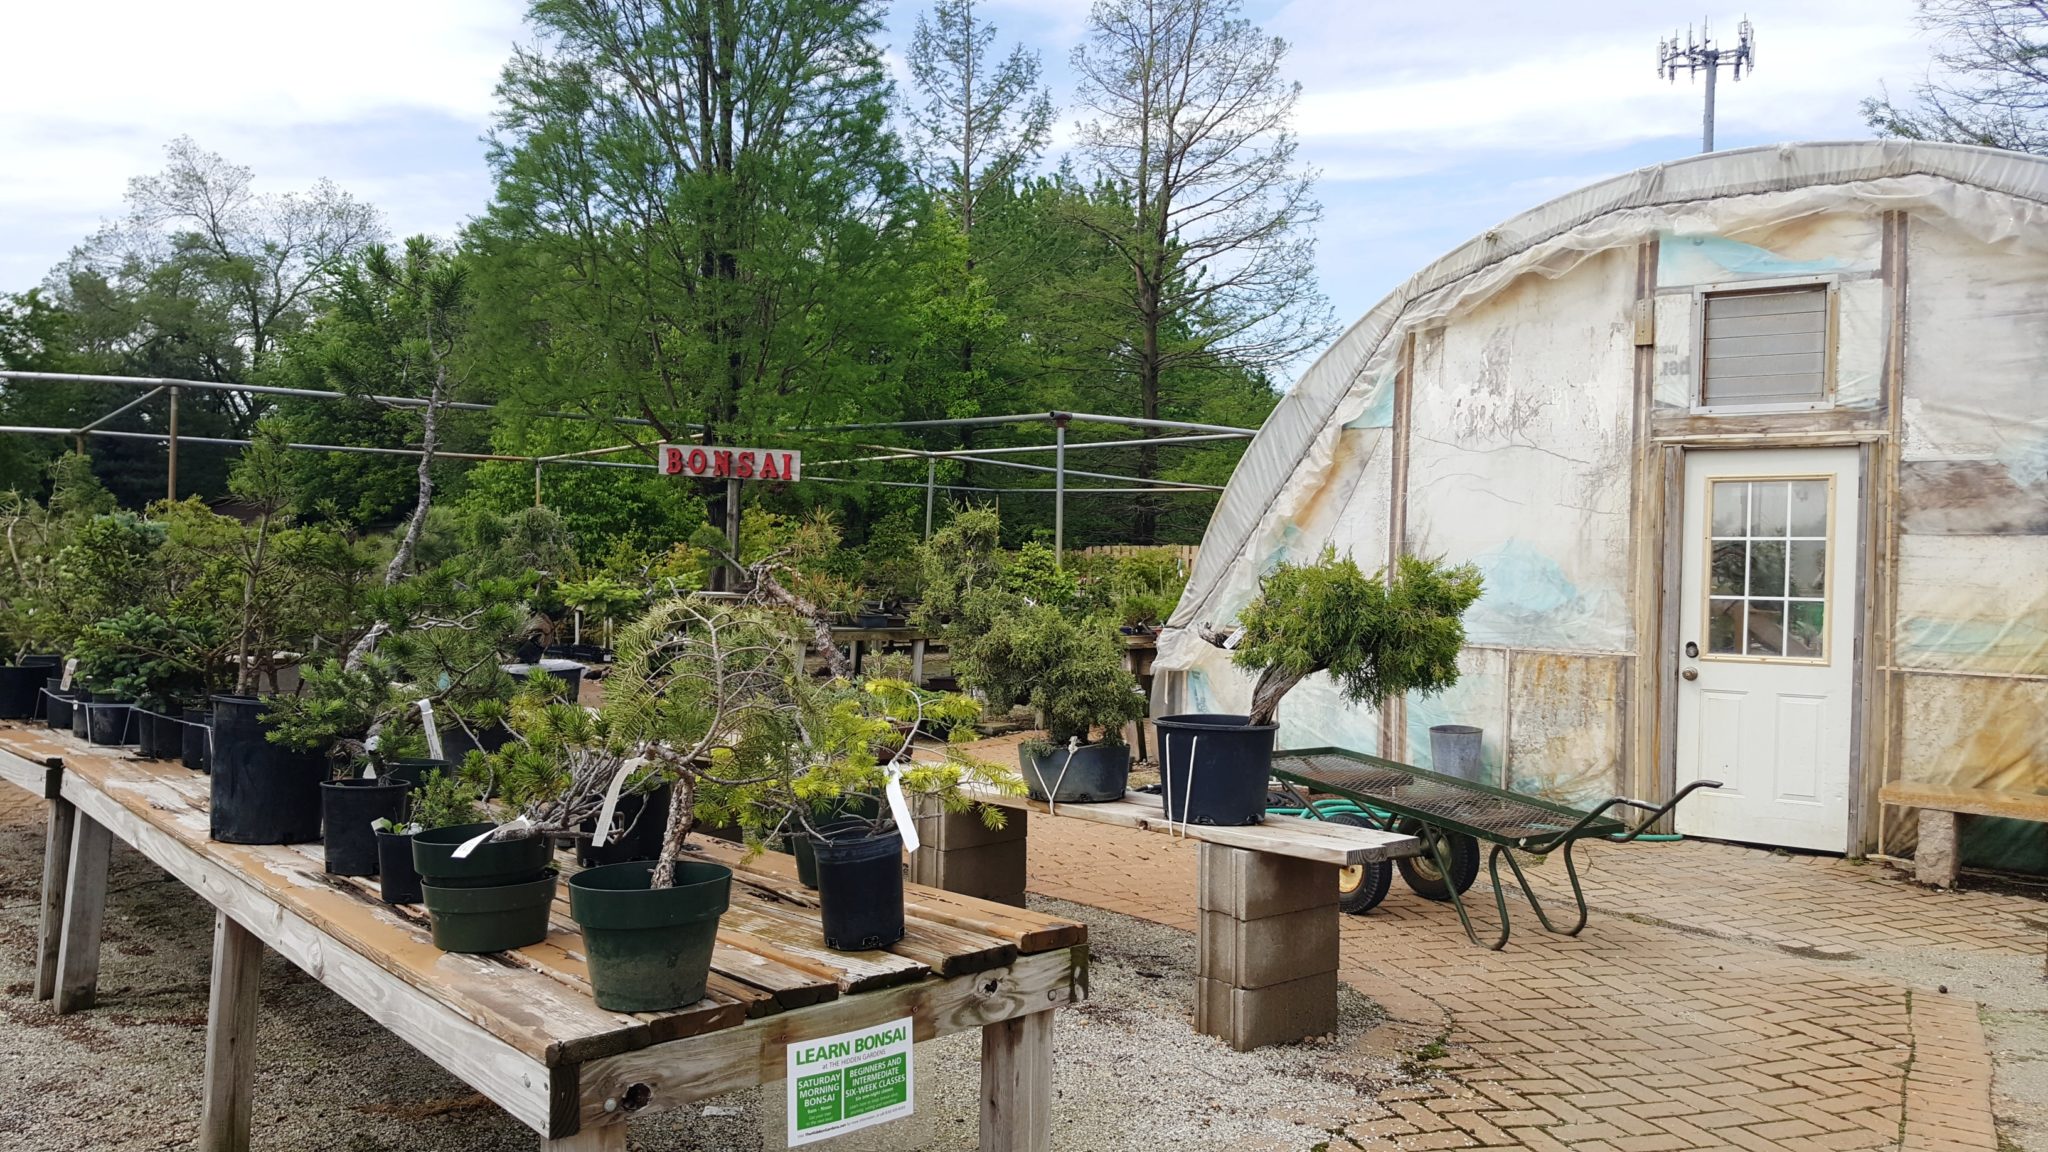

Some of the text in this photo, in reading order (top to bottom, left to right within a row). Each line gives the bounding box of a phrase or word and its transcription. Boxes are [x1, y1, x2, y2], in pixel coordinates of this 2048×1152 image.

[666, 448, 792, 480] BONSAI
[796, 1026, 906, 1066] LEARN BONSAI
[829, 1060, 840, 1068] THE
[841, 1055, 862, 1066] HIDDEN
[862, 1048, 886, 1061] GARDENS
[849, 1056, 902, 1078] BEGINNERS AND
[798, 1073, 841, 1090] SATURDAY
[845, 1074, 906, 1098] SIX-WEEK CLASSES
[852, 1066, 899, 1087] INTERMEDIATE
[799, 1083, 840, 1099] MORNING
[804, 1094, 835, 1107] BONSAI
